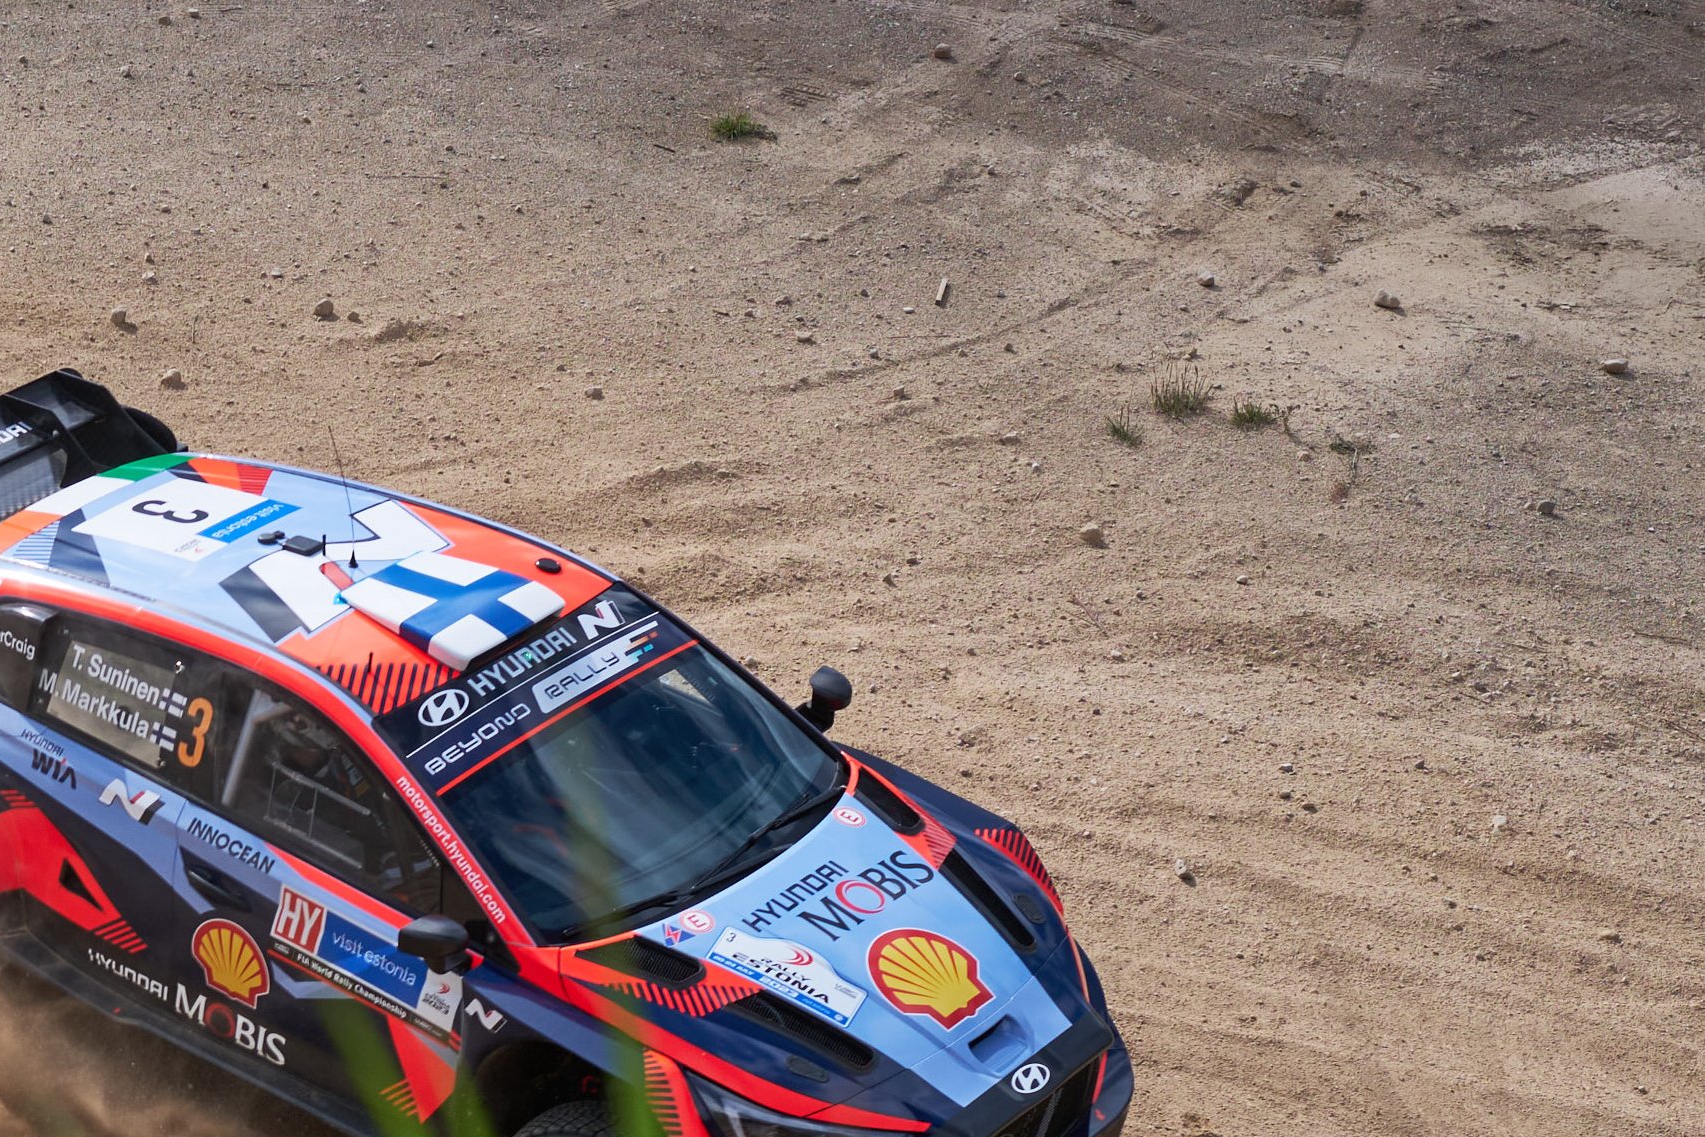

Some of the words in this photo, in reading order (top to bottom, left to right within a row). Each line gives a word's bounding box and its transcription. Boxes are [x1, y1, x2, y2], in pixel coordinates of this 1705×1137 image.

[131, 500, 209, 523] 3
[72, 645, 86, 670] T.
[88, 653, 160, 706] Suninen
[467, 627, 577, 697] HYUNDAI
[38, 668, 60, 697] M.
[62, 678, 150, 739] Markkula
[177, 697, 214, 768] 3
[424, 702, 531, 776] BEYOND
[544, 651, 620, 700] RALLY
[20, 728, 65, 757] HYUNDAI
[30, 748, 77, 790] WIA
[186, 817, 276, 874] INNOCEAN
[396, 776, 507, 924] motorsport.hyundai.com
[277, 892, 322, 946] HY
[741, 860, 850, 933] HYUNDAI
[796, 850, 935, 942] MOBIS
[332, 930, 363, 958] visit
[364, 950, 417, 987] estonia
[726, 932, 737, 943] 3
[296, 953, 310, 967] FIA
[311, 960, 333, 979] World
[333, 971, 354, 991] Rally
[354, 983, 407, 1019] Championship
[732, 951, 830, 1004] ESTONIA
[761, 956, 812, 982] RALLY
[88, 947, 169, 1001] HYUNDAI
[175, 983, 287, 1066] MOBIS
